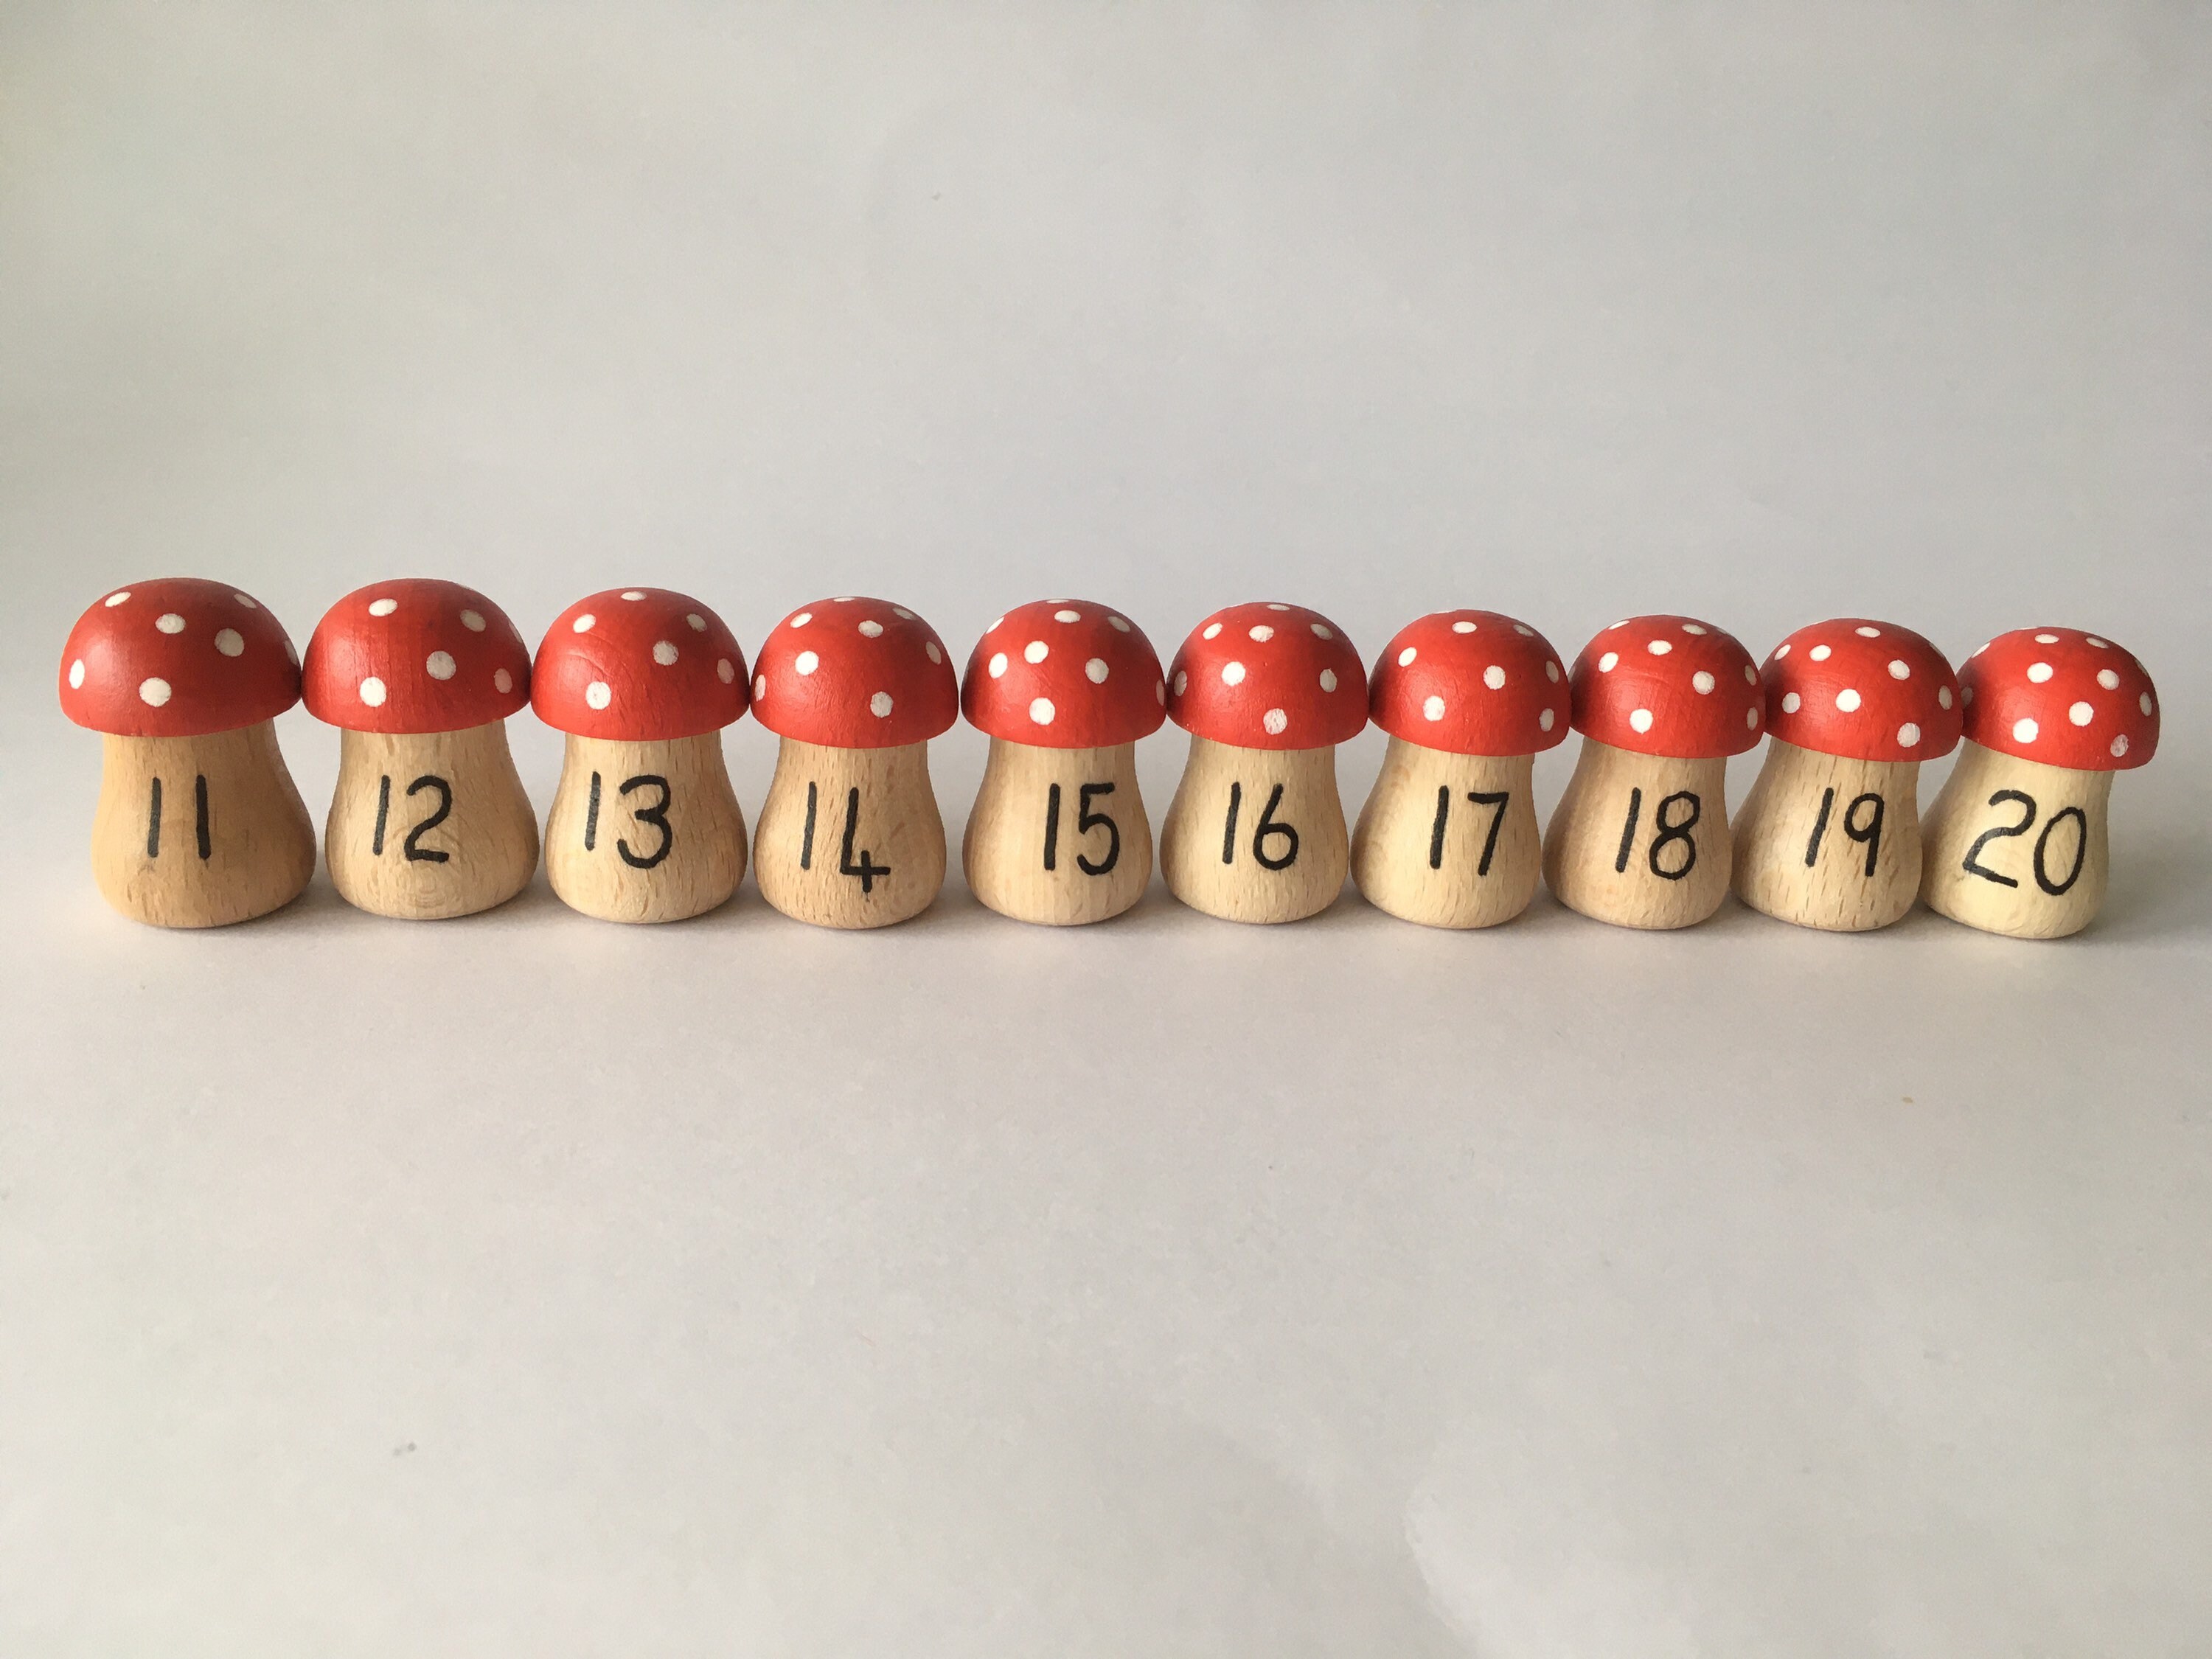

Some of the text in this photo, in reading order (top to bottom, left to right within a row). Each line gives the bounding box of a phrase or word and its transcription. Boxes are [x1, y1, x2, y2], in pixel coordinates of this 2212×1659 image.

[145, 773, 212, 862] 11
[374, 774, 454, 864] 12
[583, 771, 672, 870] 13
[804, 781, 892, 895] 14
[1043, 781, 1121, 877] 15
[1222, 781, 1300, 872] 16
[1429, 785, 1511, 877] 17
[1615, 786, 1702, 882] 18
[1805, 787, 1886, 878] 19
[1962, 789, 2088, 897] 20
